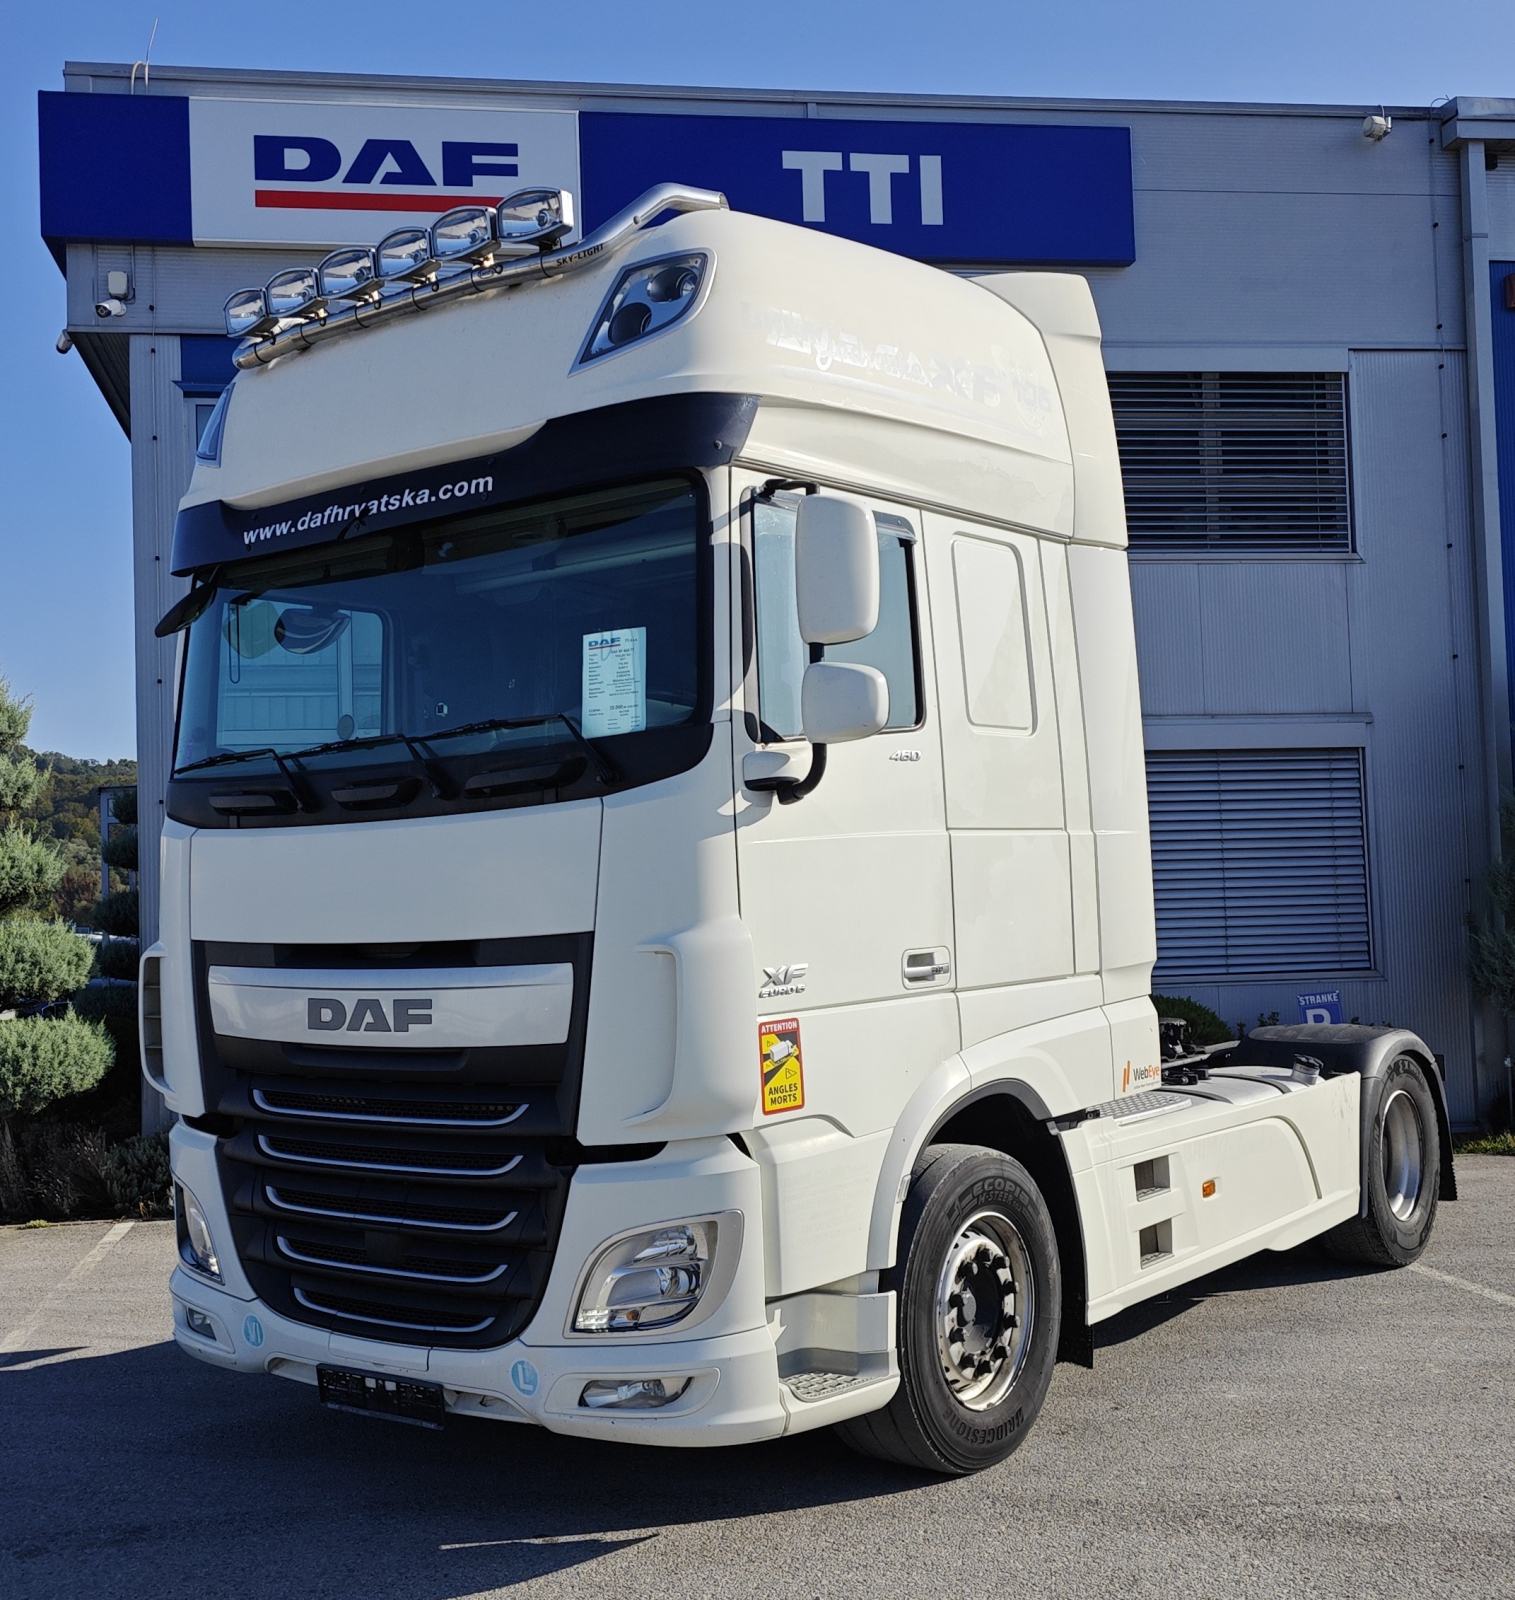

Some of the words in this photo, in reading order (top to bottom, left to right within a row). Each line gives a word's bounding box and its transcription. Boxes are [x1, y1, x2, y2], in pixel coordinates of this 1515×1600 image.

[253, 134, 519, 187] DAF
[782, 150, 944, 226] TTI
[556, 243, 605, 267] SKY-LIGHT
[243, 475, 494, 545] www.dafhrvatska.com
[588, 637, 621, 648] DAF
[759, 962, 809, 989] XF
[1299, 992, 1339, 1006] STRANKE
[307, 998, 433, 1032] DAF
[761, 1020, 798, 1034] ATTENTION
[1132, 1064, 1160, 1081] WebEye
[768, 1082, 798, 1097] ANGLES
[770, 1093, 798, 1107] MORTS
[518, 1363, 537, 1391] L
